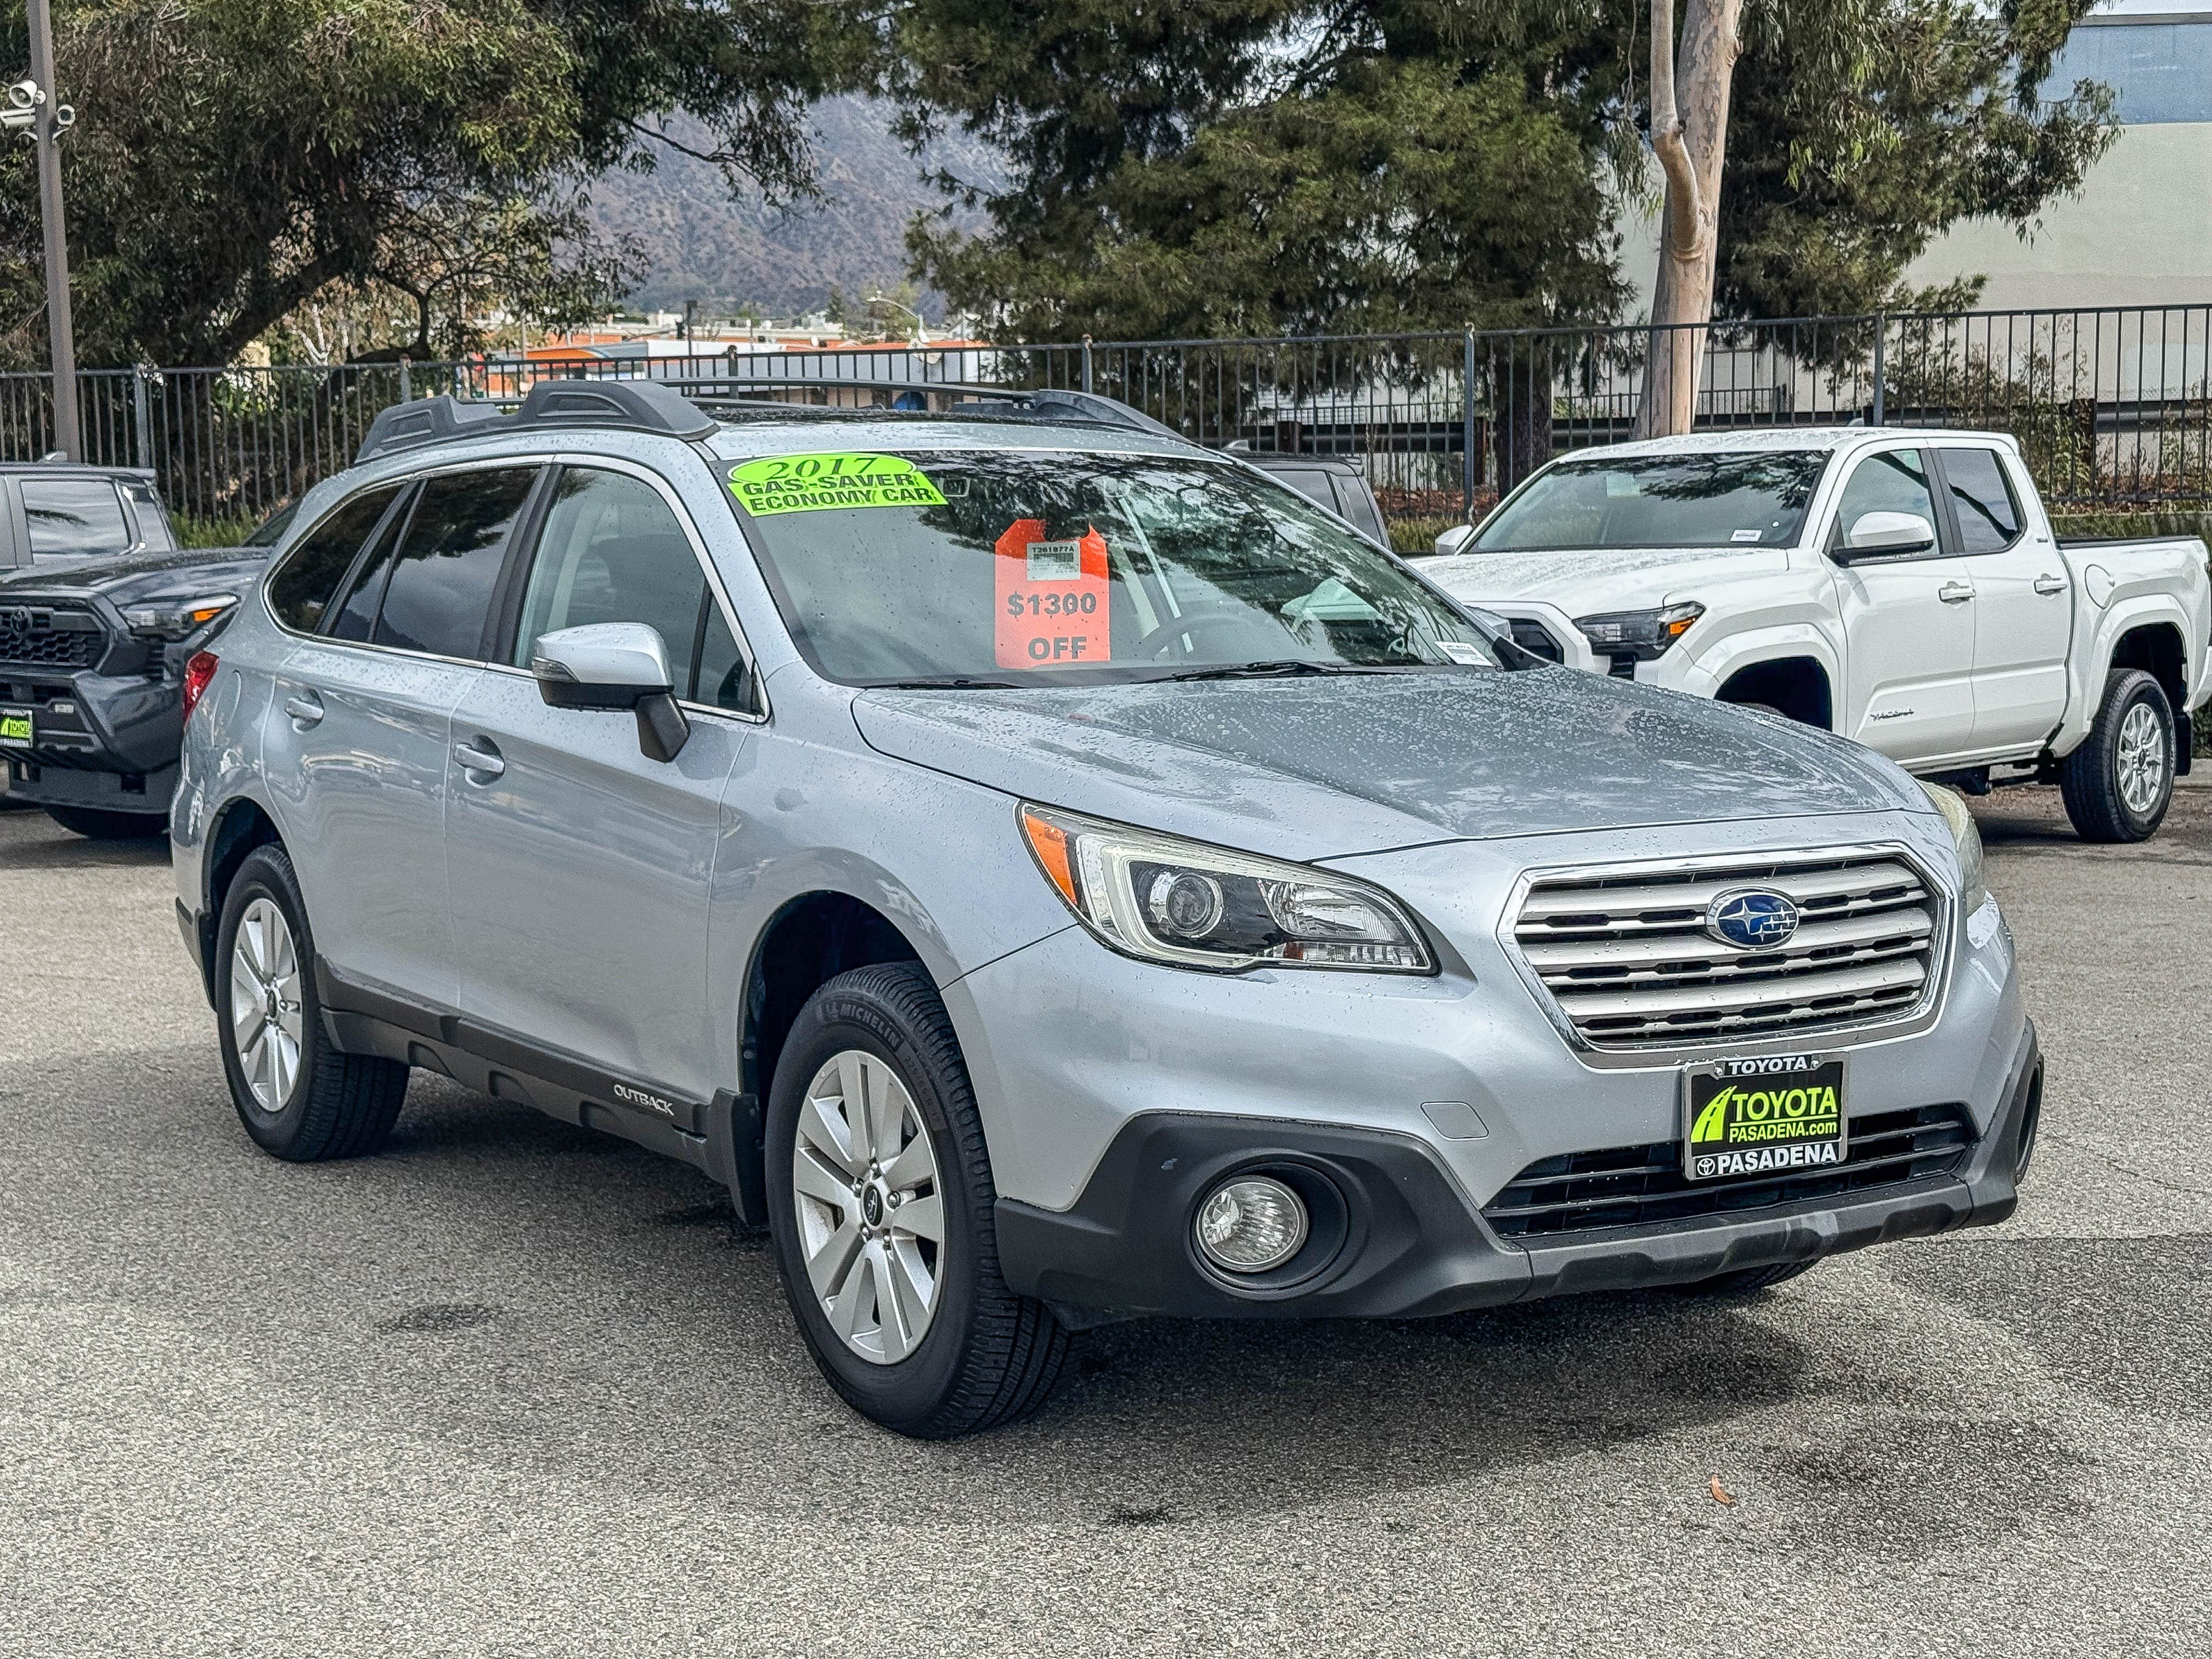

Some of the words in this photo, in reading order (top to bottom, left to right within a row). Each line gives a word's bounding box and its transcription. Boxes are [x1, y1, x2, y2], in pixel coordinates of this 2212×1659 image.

[766, 457, 878, 480] 2017
[743, 473, 915, 496] GAS-SAVER
[751, 489, 875, 512] ECONOMY
[882, 488, 934, 503] CAR
[1007, 591, 1096, 618] $1300
[1028, 636, 1087, 660] OFF
[840, 1003, 900, 1048] MICHELIN
[1728, 1057, 1808, 1075] TOYOTA
[613, 1084, 675, 1116] OUTBACK
[1731, 1086, 1838, 1122] TOYOTA
[1729, 1121, 1837, 1143] PASADENA.com
[1717, 1143, 1837, 1175] PASADENA
